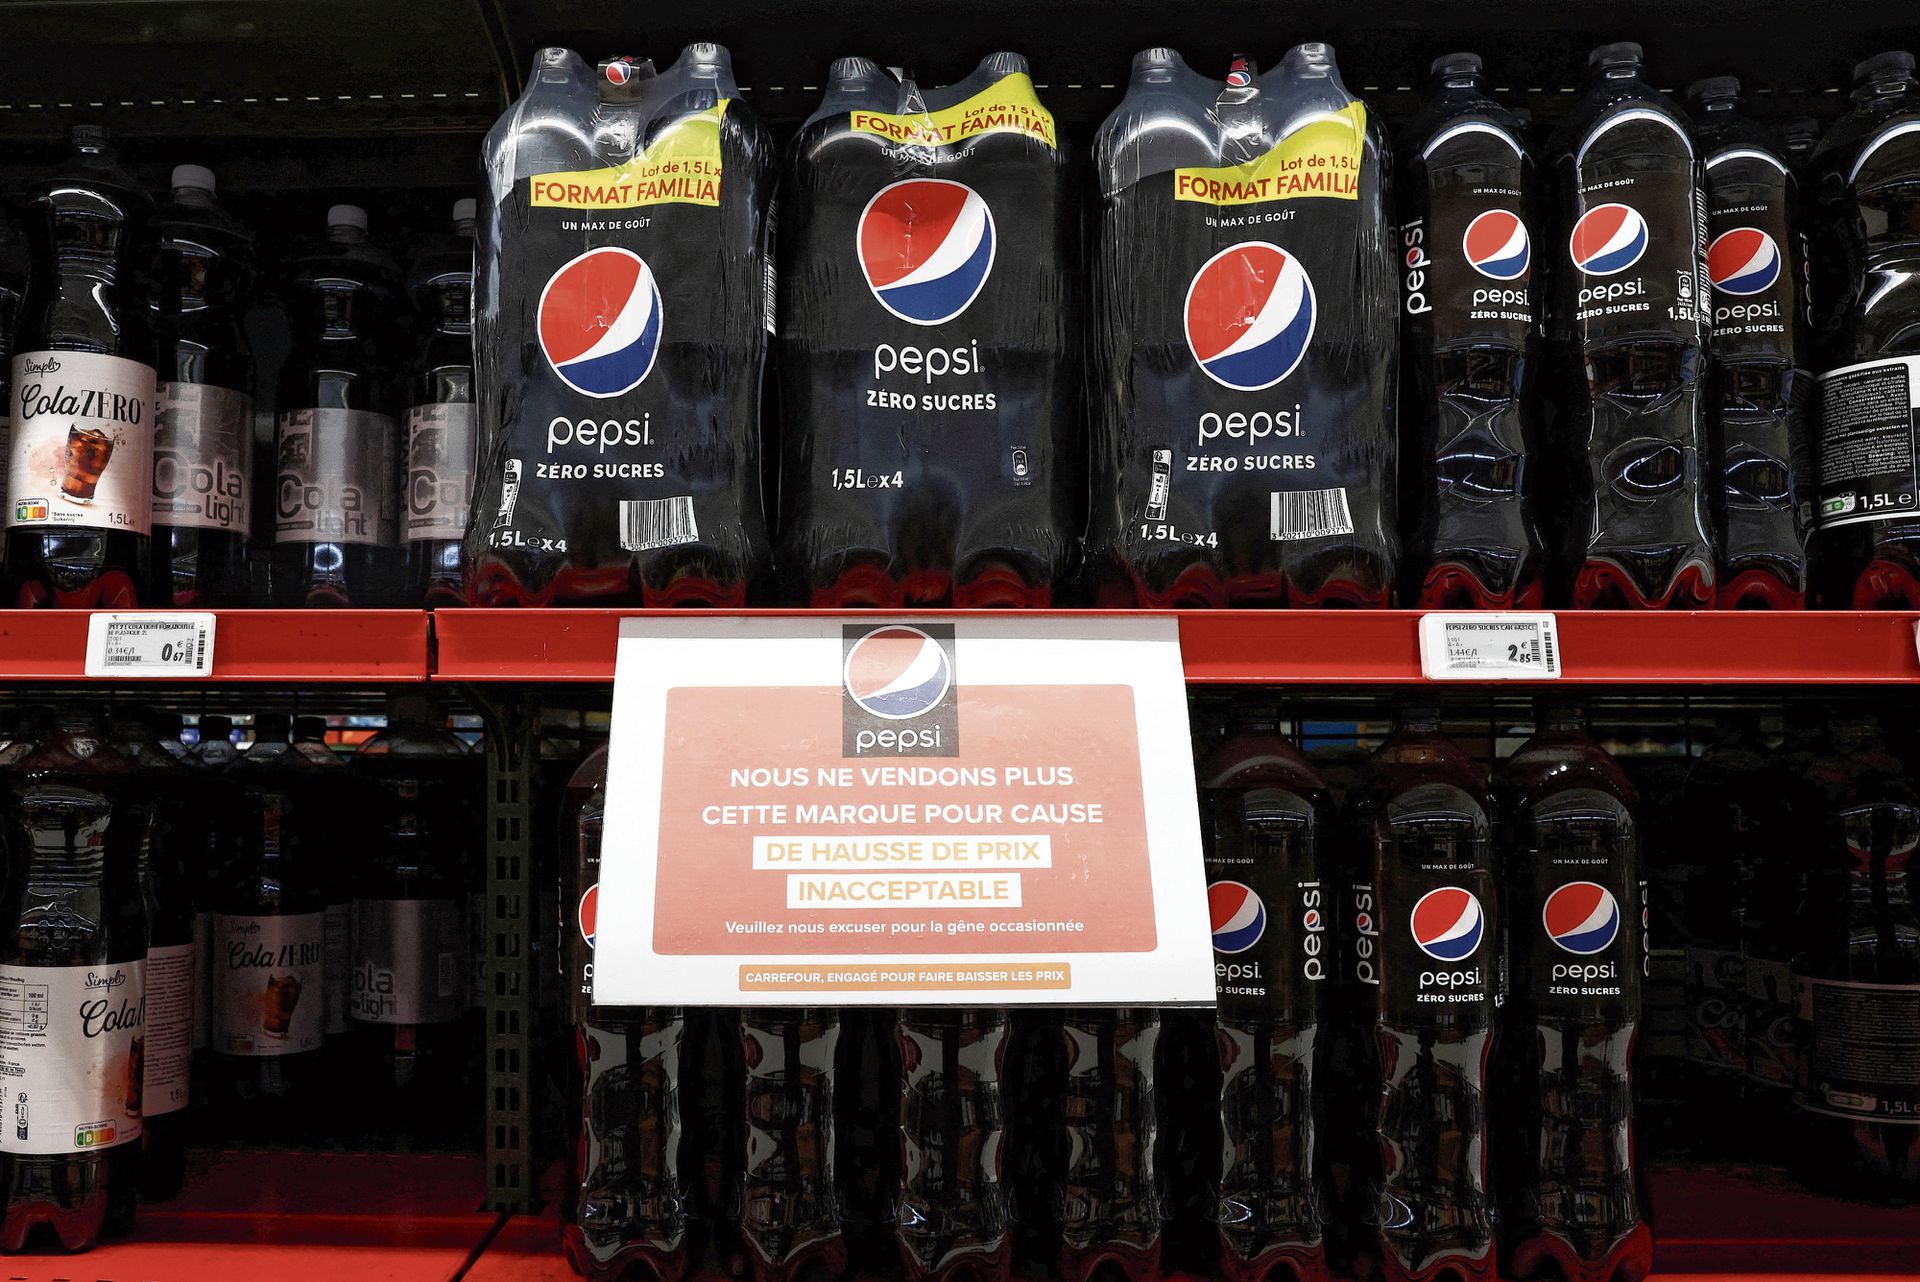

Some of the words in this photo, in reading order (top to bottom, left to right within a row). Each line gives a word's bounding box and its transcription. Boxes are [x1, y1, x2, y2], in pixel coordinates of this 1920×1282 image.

[965, 107, 985, 119] Lot
[988, 104, 1007, 112] de
[856, 115, 956, 142] FORMAT
[881, 147, 896, 159] UN
[946, 147, 976, 162] GOÛT
[1281, 157, 1303, 172] Lot
[1307, 154, 1326, 167] de
[642, 165, 660, 177] Lot
[662, 161, 680, 174] de
[535, 181, 633, 204] FORMAT
[1179, 175, 1271, 201] FORMAT
[1277, 171, 1358, 195] FAMILIA
[1587, 183, 1604, 192] MAX
[1604, 181, 1614, 189] DE
[1614, 177, 1635, 187] GOÛT
[1205, 216, 1217, 228] UN
[1220, 216, 1245, 228] MAX
[1248, 216, 1262, 225] DE
[1264, 209, 1296, 224] GOÛT
[1723, 207, 1739, 215] MAX
[1750, 204, 1769, 213] GOÛT
[562, 220, 578, 231] UN
[580, 220, 606, 231] MAX
[608, 220, 622, 231] DE
[624, 216, 651, 230] GOÛT
[1400, 219, 1433, 315] pepsi
[1473, 288, 1528, 307] pepsi
[1578, 277, 1642, 308] pepsi
[1470, 311, 1498, 319] ZÉRO
[1500, 311, 1532, 323] SUCRES
[1576, 308, 1603, 321] ZÉRO
[1605, 303, 1650, 314] SUCRES
[1715, 300, 1777, 325] pepsi
[1745, 324, 1785, 333] SUCRES
[874, 338, 979, 385] pepsi
[21, 383, 80, 420] Cola
[866, 389, 917, 410] ZÉRO
[922, 393, 997, 412] SUCRES
[547, 412, 650, 454] pepsi
[1198, 403, 1300, 446] pepsi
[536, 462, 588, 479] ZÉRO
[593, 463, 665, 479] SUCRES
[1186, 453, 1238, 472] ZÉRO
[1243, 454, 1316, 471] SUCRES
[152, 451, 243, 499] Cola
[278, 474, 361, 519] Coa
[410, 469, 471, 515] Col
[205, 495, 244, 527] light
[161, 643, 173, 662] 0
[173, 652, 184, 662] 67
[1507, 644, 1518, 662] 2
[1519, 653, 1531, 663] 85
[856, 724, 942, 754] pepsi
[730, 768, 809, 788] NOUS
[817, 768, 853, 788] NE
[860, 767, 997, 787] VENDONS
[1005, 767, 1074, 787] PLUS
[702, 805, 786, 825] CETTE
[796, 804, 916, 825] MARQUE
[925, 804, 1003, 824] POUR
[1010, 803, 1103, 824] CAUSE
[766, 843, 803, 862] DE
[811, 842, 923, 862] HAUSSE
[932, 842, 968, 861] DE
[977, 841, 1040, 861] PRIX
[798, 880, 1009, 902] INACCEPTABLE
[725, 920, 784, 934] Veuillez
[788, 922, 825, 934] nous
[828, 922, 886, 934] excuser
[891, 922, 927, 937] pour
[930, 920, 944, 933] la
[947, 919, 985, 936] gêne
[989, 919, 1084, 933] occasionnée
[1297, 881, 1326, 981] pepsi
[1352, 883, 1380, 985] pepsi
[227, 941, 276, 970] Cola
[354, 961, 394, 994] ola
[745, 971, 824, 984] CARREFOUR,
[827, 969, 877, 983] ENGAGÉ
[880, 971, 916, 982] POUR
[918, 971, 953, 982] FAIRE
[957, 971, 1009, 982] BAISSER
[1011, 970, 1033, 981] LES
[1036, 970, 1064, 981] PRIX
[1215, 961, 1259, 982] epsi
[1419, 966, 1480, 990] pepsi
[1552, 961, 1615, 982] pepsi
[1225, 986, 1266, 996] SUCRES
[1416, 993, 1445, 1002] ZÉRO
[1448, 993, 1484, 1003] SUCRES
[1549, 986, 1578, 996] ZÉRO
[1581, 986, 1620, 996] SUCRES
[360, 994, 395, 1018] ligh
[79, 998, 137, 1038] Cola
